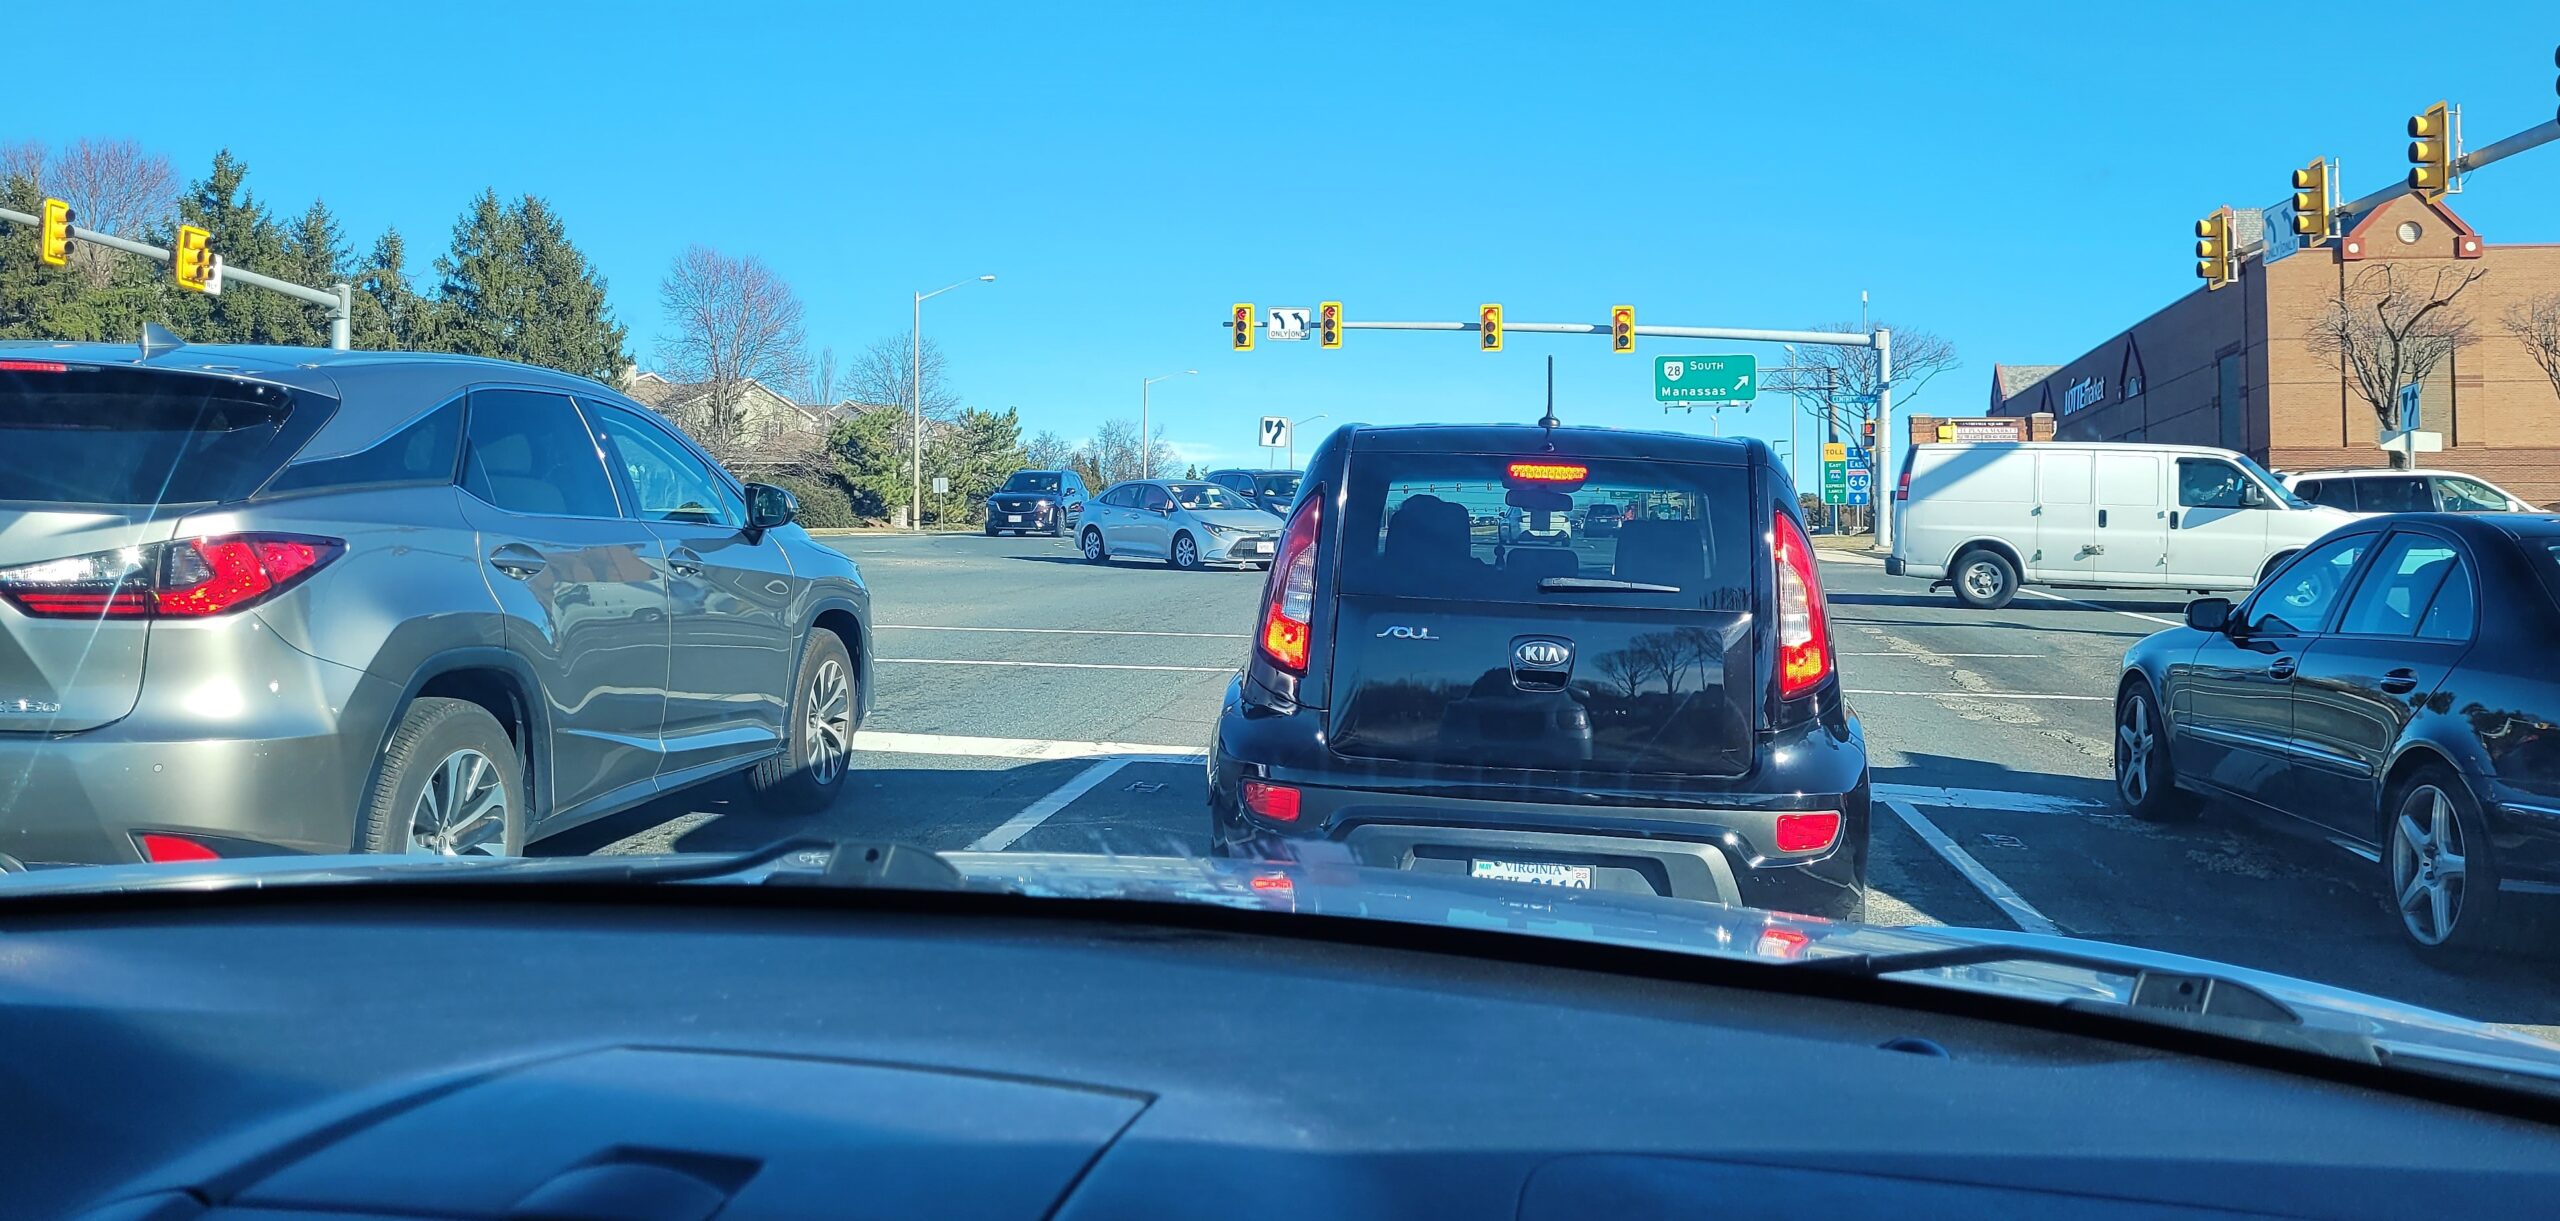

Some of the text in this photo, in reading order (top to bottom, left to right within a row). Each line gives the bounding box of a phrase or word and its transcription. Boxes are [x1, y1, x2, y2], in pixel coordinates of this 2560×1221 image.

[1270, 330, 1308, 338] ONLY ONLY
[1667, 361, 1725, 377] 28 SOUTH
[1661, 386, 1727, 397] Manassas
[1826, 448, 1844, 456] TOLL
[1849, 476, 1867, 487] 66
[1376, 625, 1440, 640] SOUL
[1525, 646, 1561, 662] KIA
[1505, 862, 1562, 876] VIRGINIA
